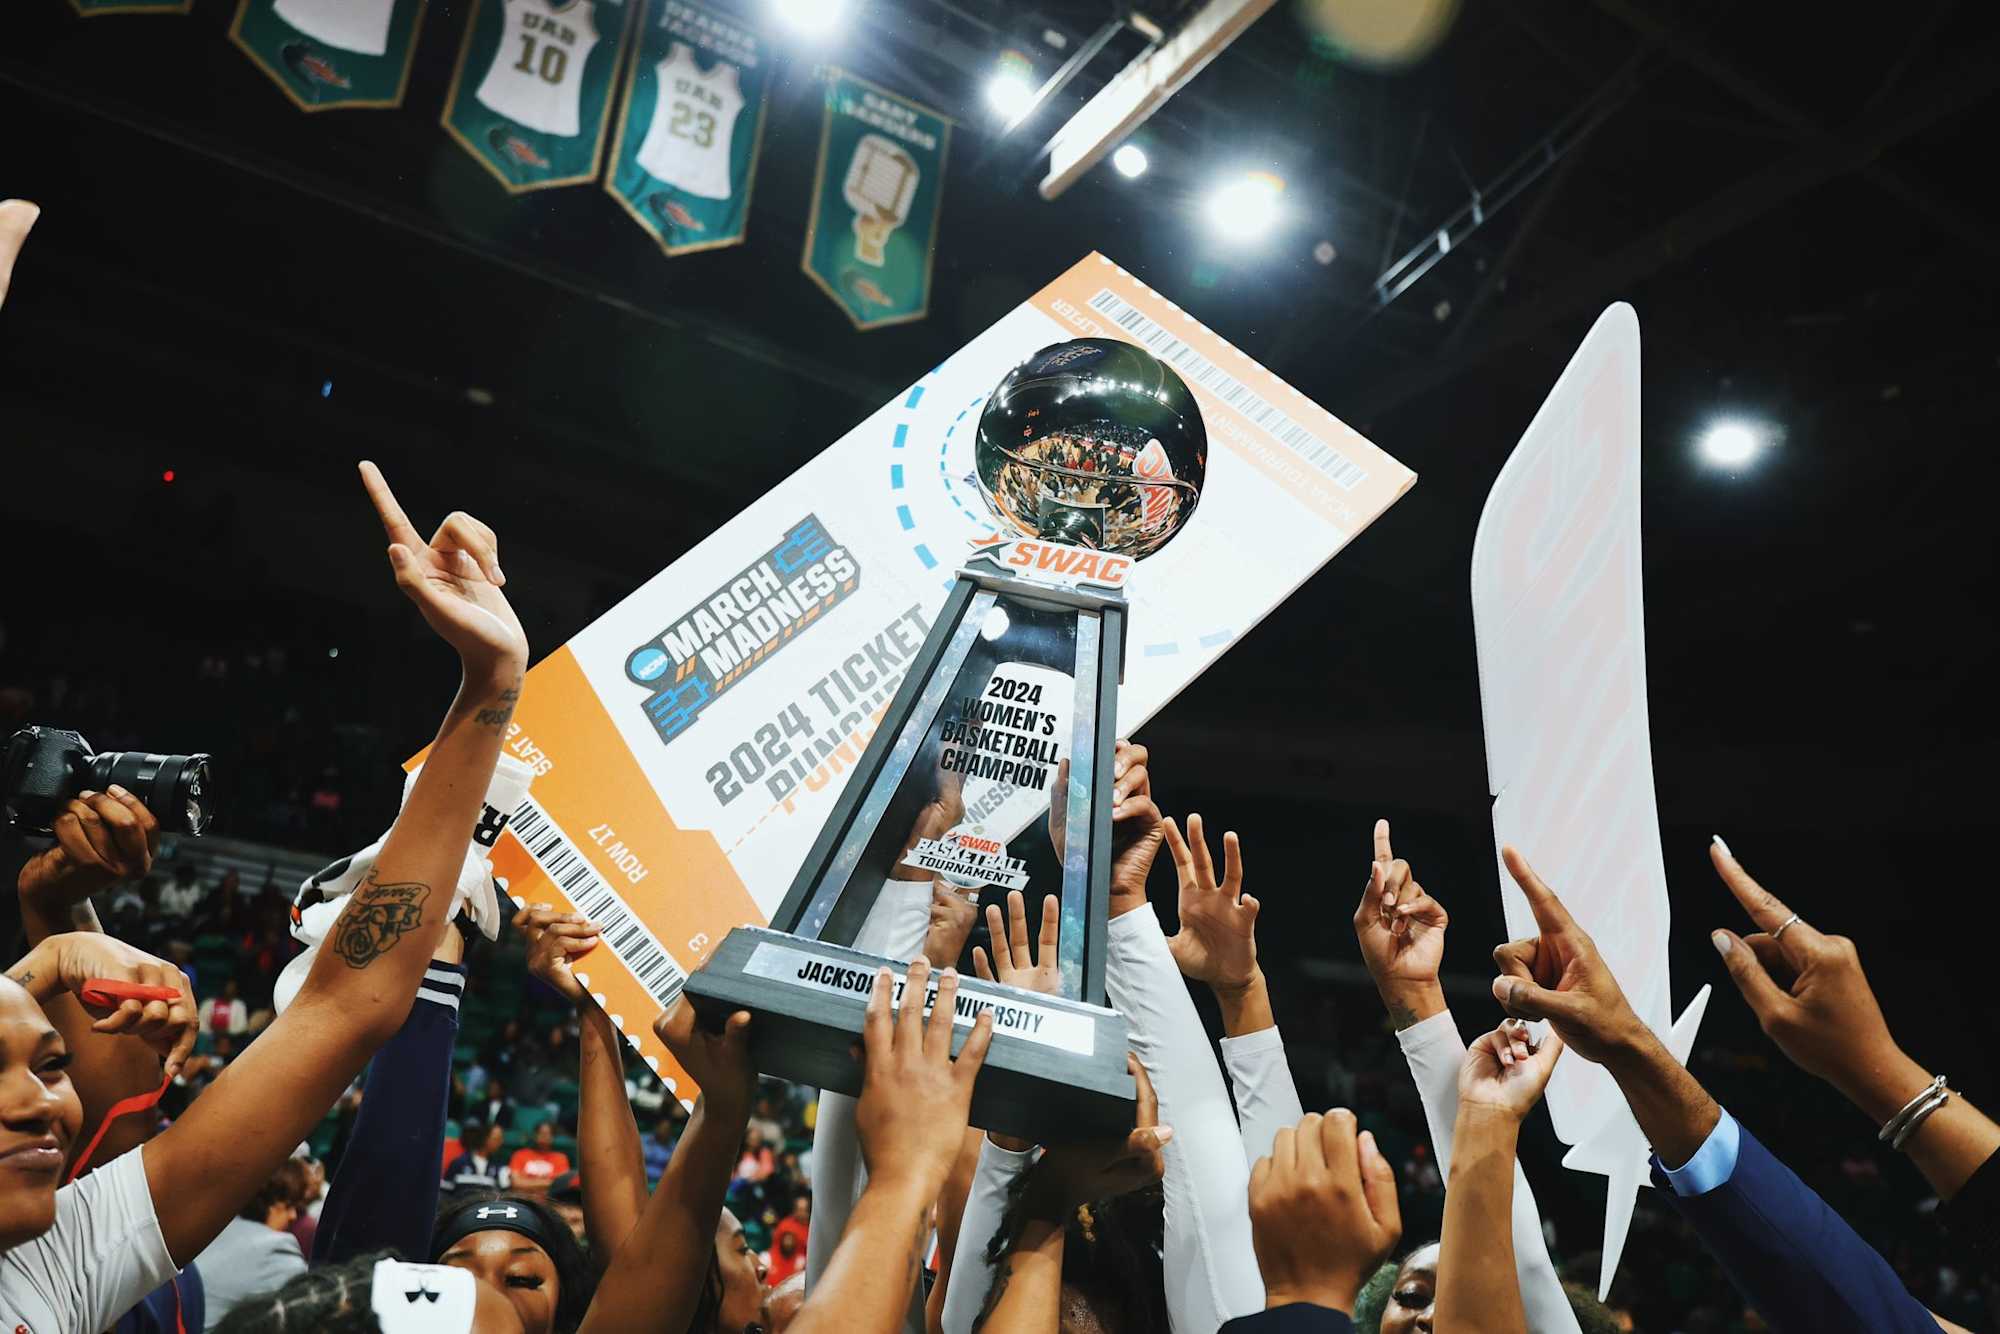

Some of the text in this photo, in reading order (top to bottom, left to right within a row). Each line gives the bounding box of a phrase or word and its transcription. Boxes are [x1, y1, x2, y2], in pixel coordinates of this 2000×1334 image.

[512, 33, 569, 86] 10
[668, 101, 717, 148] 23
[1050, 297, 1107, 339] LIFIER
[1008, 542, 1130, 583] SWAC
[661, 561, 782, 665] MARCH
[699, 548, 856, 681] MADNESS
[705, 602, 932, 808] 2024 TICKET
[988, 676, 1043, 706] 2024
[961, 697, 1057, 736] WOMEN'S
[510, 736, 553, 777] SEAT
[940, 720, 1060, 766] BASKETBALL
[940, 748, 1049, 791] CHAMPION
[587, 823, 649, 884] ROW 17
[916, 838, 1028, 875] BASKETBALL
[958, 834, 1002, 854] SWAC
[918, 854, 1015, 885] TOURNAMENT
[954, 994, 1044, 1033] NIVRSITY
